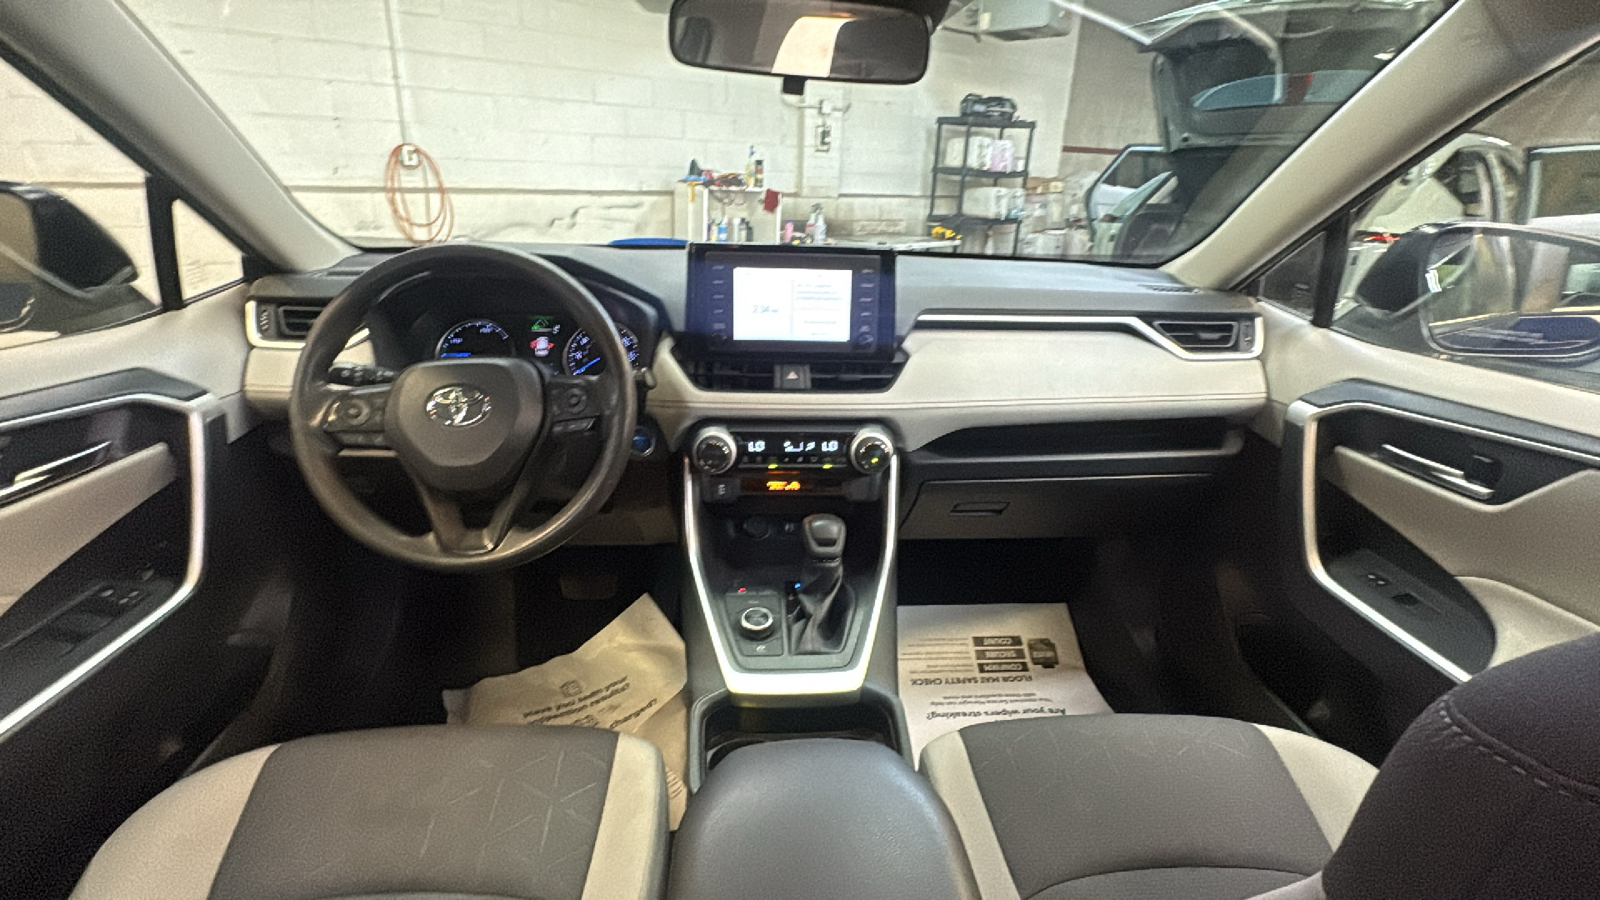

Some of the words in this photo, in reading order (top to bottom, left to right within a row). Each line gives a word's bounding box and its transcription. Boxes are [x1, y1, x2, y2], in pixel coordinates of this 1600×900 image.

[910, 678, 942, 686] CHECK
[945, 677, 978, 685] SAFETY
[979, 676, 1000, 684] MAT
[1001, 675, 1032, 683] FLOOR
[984, 708, 1020, 717] wipers
[1022, 706, 1047, 715] your
[1047, 707, 1066, 716] Are
[926, 711, 982, 720] streaking?
